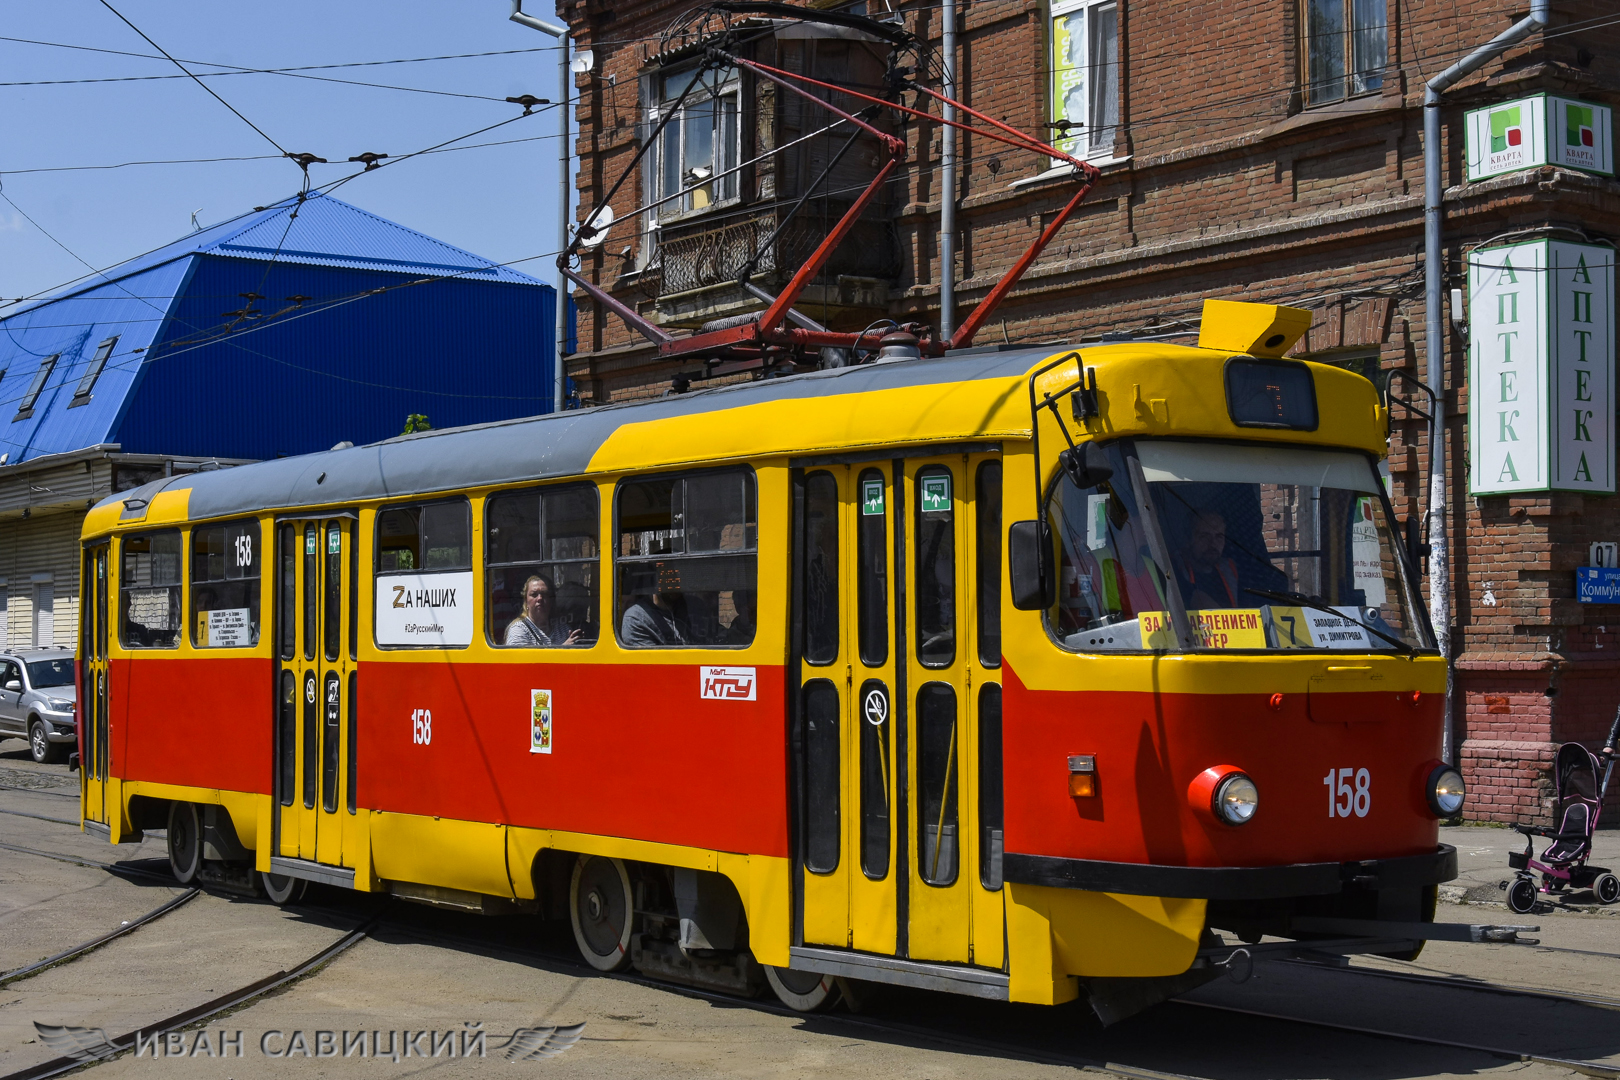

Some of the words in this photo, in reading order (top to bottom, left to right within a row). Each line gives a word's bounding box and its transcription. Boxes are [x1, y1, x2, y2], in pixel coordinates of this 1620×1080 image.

[1490, 151, 1522, 165] КВАРТА
[1504, 160, 1522, 168] аптек
[1566, 148, 1594, 160] КВАРТА
[1495, 253, 1521, 483] АПТЕКА
[1571, 251, 1594, 483] АПТЕКА
[234, 534, 252, 567] 158
[415, 588, 457, 608] НАШИХ
[200, 620, 206, 640] 7
[1144, 616, 1162, 633] ЗА
[1164, 614, 1258, 632] УАВЛЕНИЕМ
[1280, 616, 1297, 645] 7
[1313, 618, 1343, 629] ЗАПАДНОЕ
[1328, 631, 1363, 642] ДИМИТРОВА
[411, 708, 432, 746] 158
[1323, 767, 1371, 818] 158
